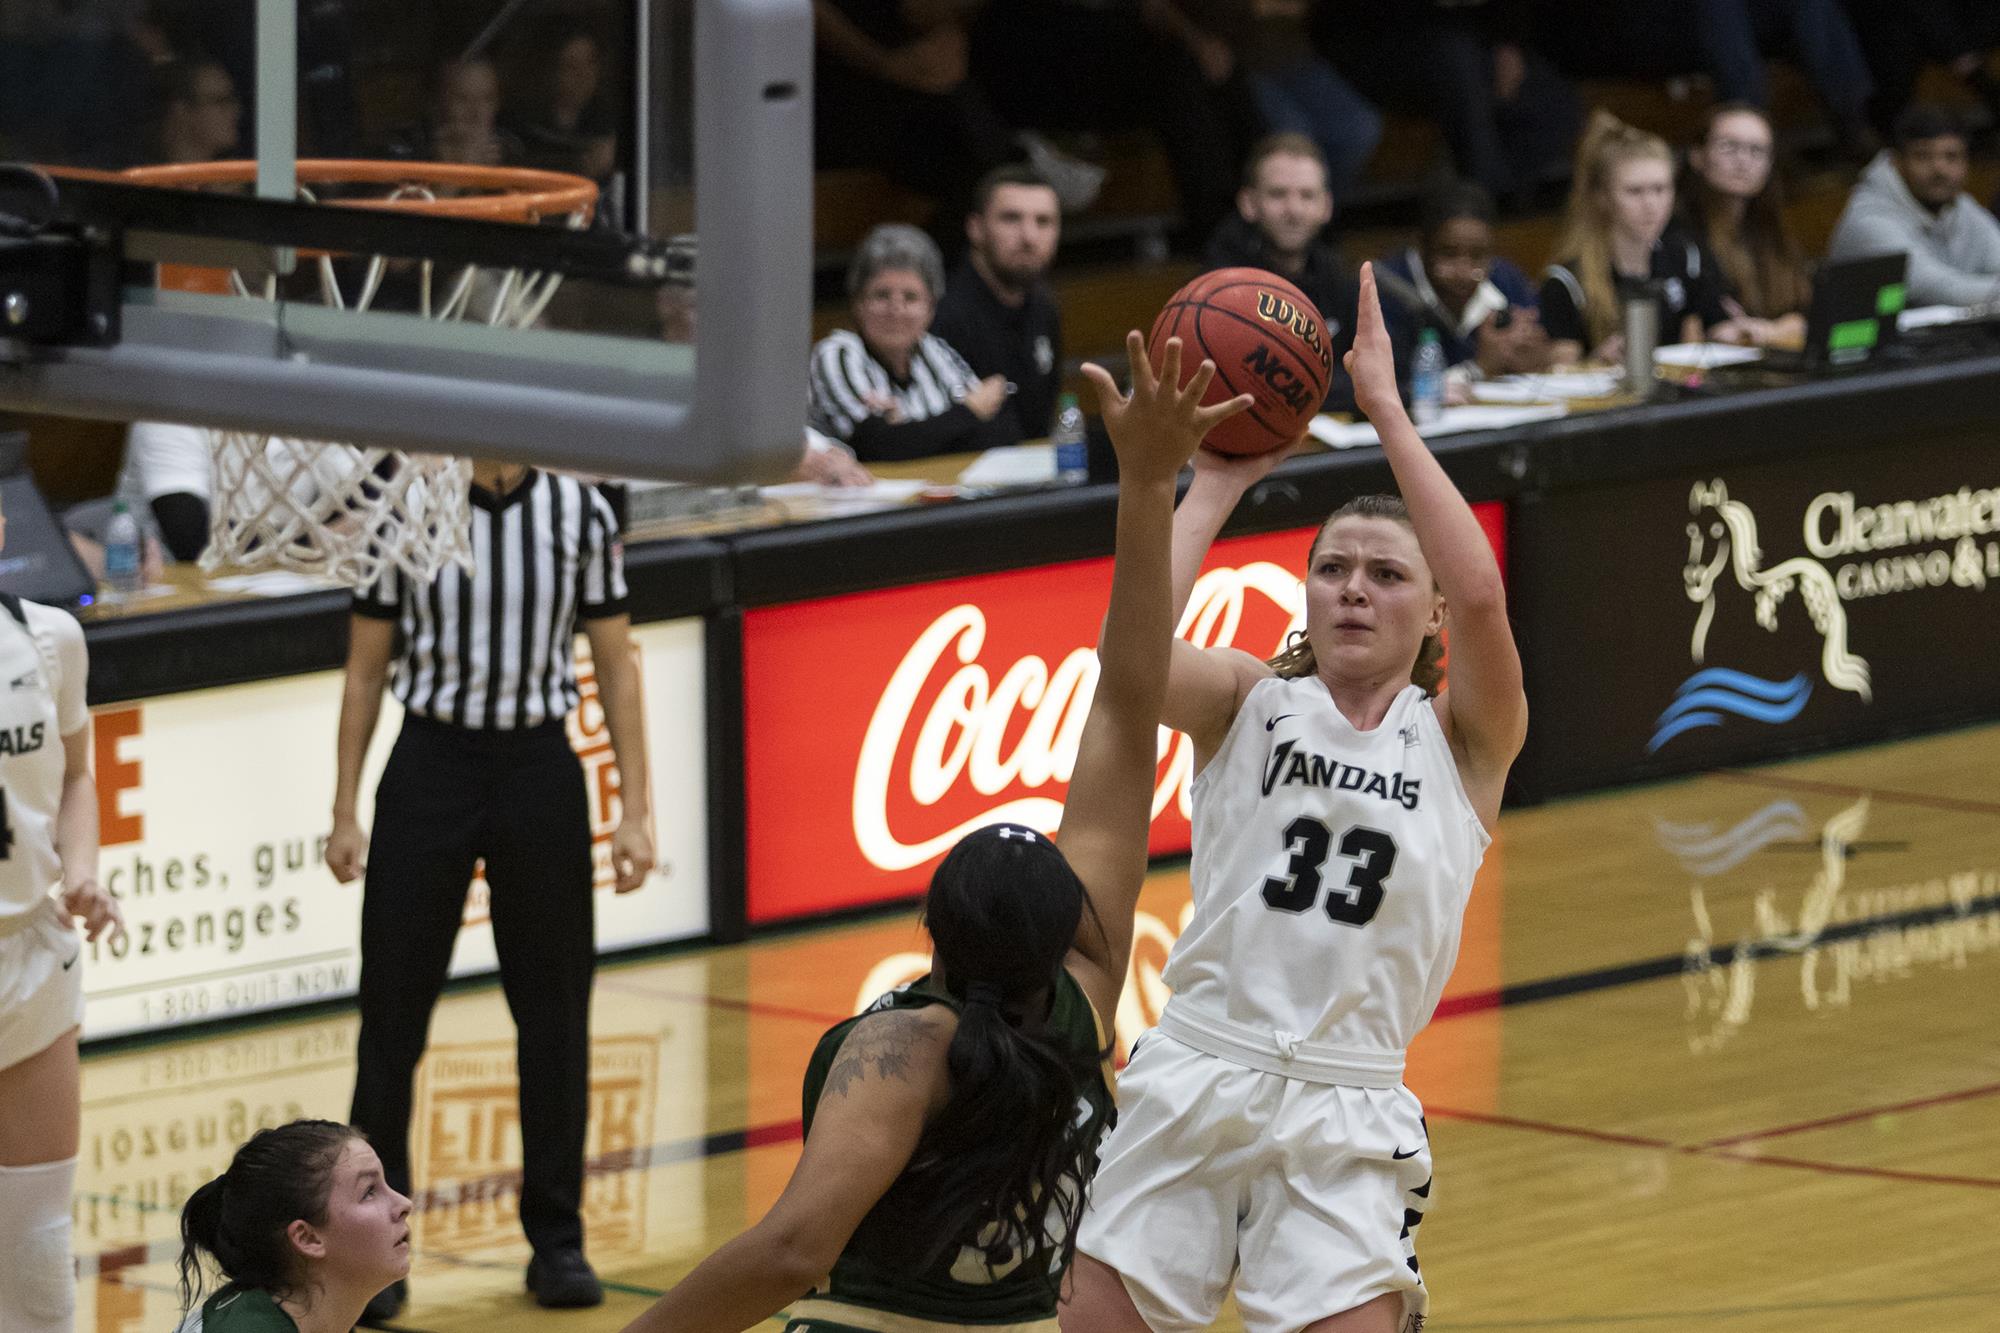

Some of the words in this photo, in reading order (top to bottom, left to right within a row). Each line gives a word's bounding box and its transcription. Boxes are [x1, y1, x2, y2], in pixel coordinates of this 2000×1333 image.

[1243, 344, 1314, 416] NCAA
[852, 603, 1101, 872] Coca
[1261, 737, 1423, 811] VANDALS
[1259, 815, 1400, 930] 33
